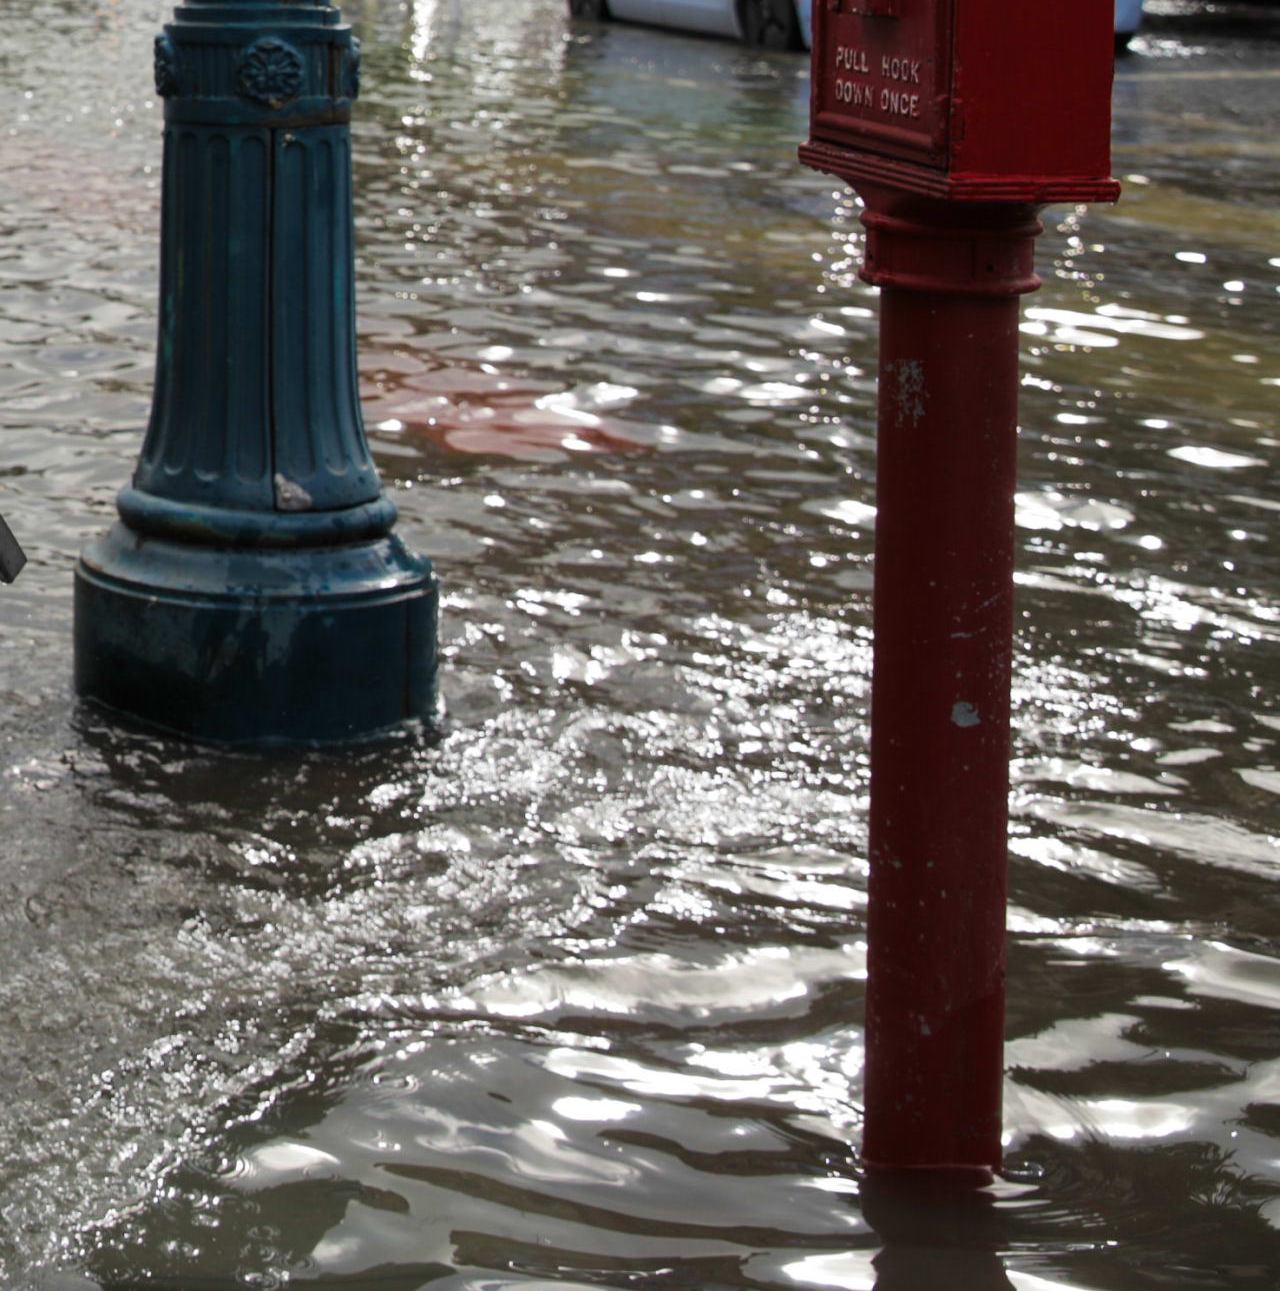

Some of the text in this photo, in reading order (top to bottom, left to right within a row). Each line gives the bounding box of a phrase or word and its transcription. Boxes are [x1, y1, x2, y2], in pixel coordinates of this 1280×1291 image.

[836, 46, 920, 84] PULL HOOK
[836, 78, 920, 117] DOWN ONCE
